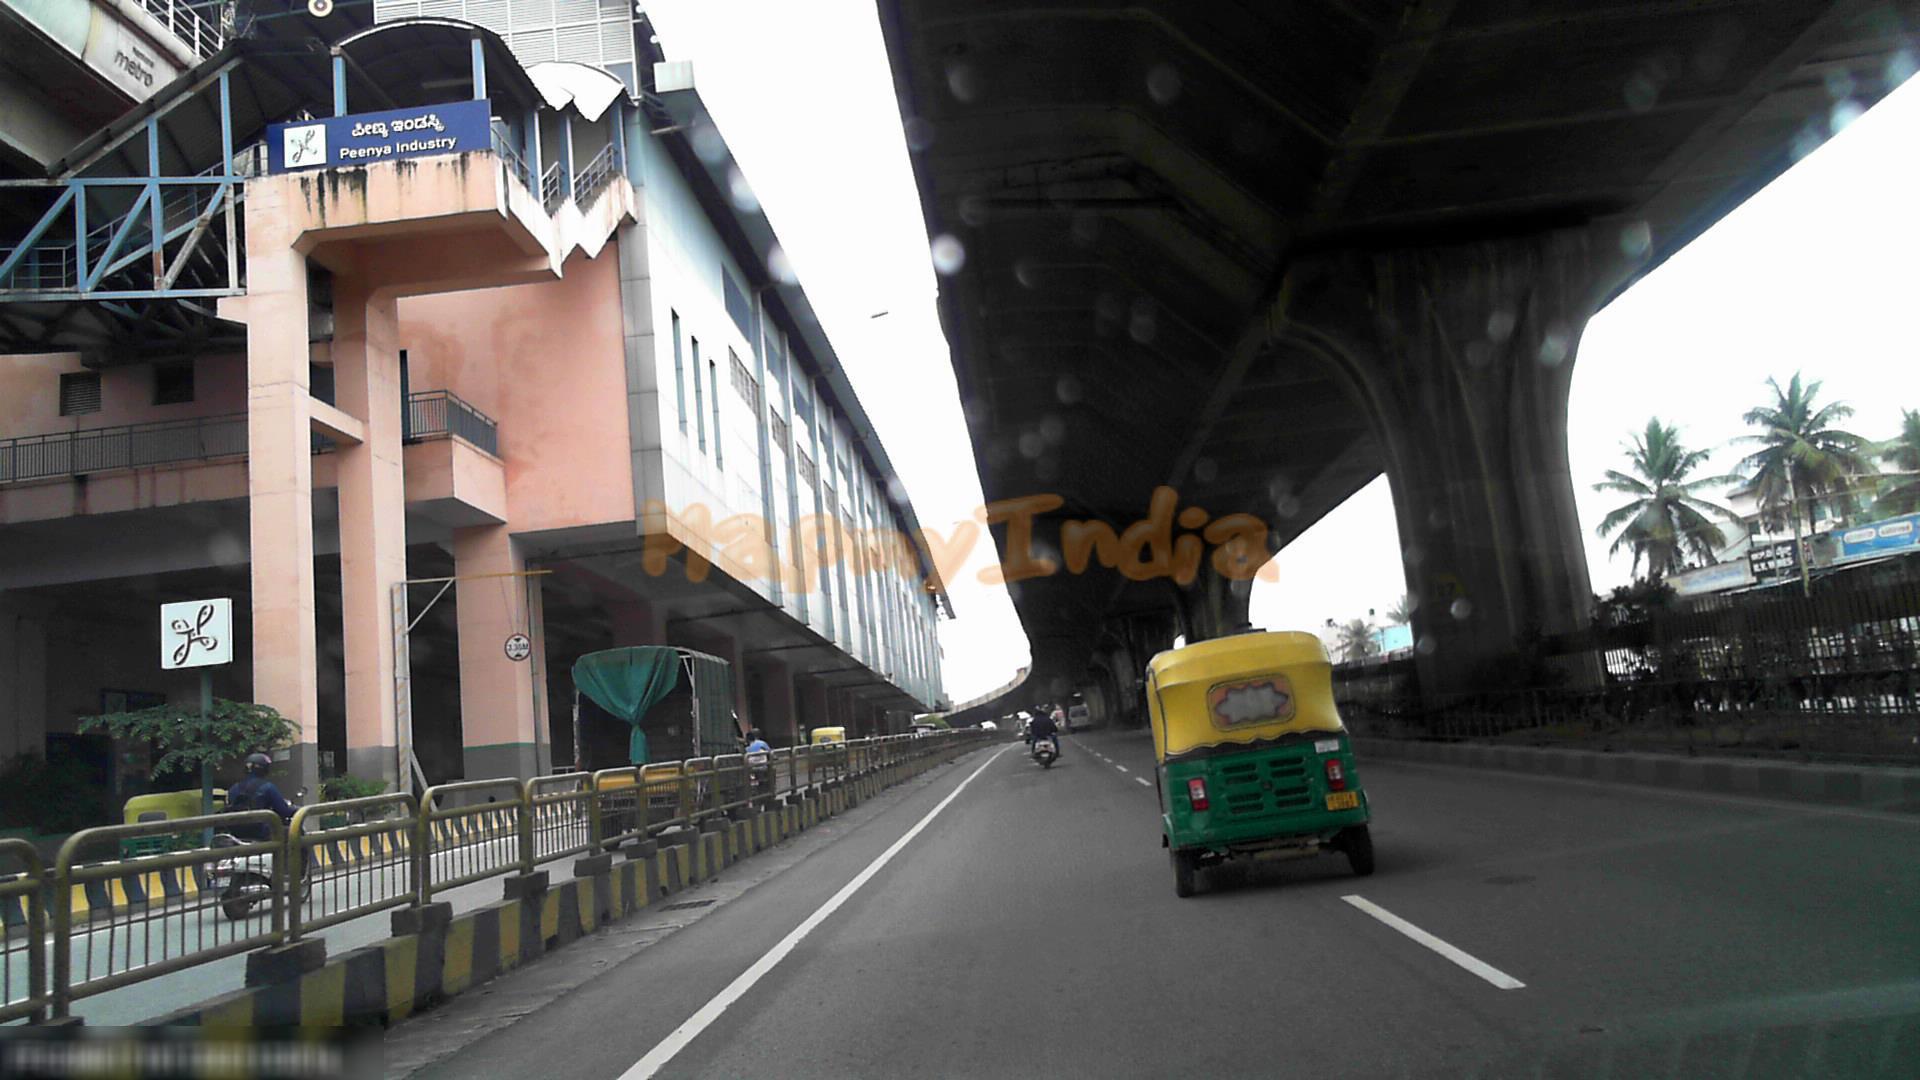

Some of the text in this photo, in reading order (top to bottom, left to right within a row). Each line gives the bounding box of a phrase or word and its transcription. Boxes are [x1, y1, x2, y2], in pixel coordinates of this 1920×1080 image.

[114, 50, 154, 88] metro
[340, 137, 457, 159] Peenya Industry
